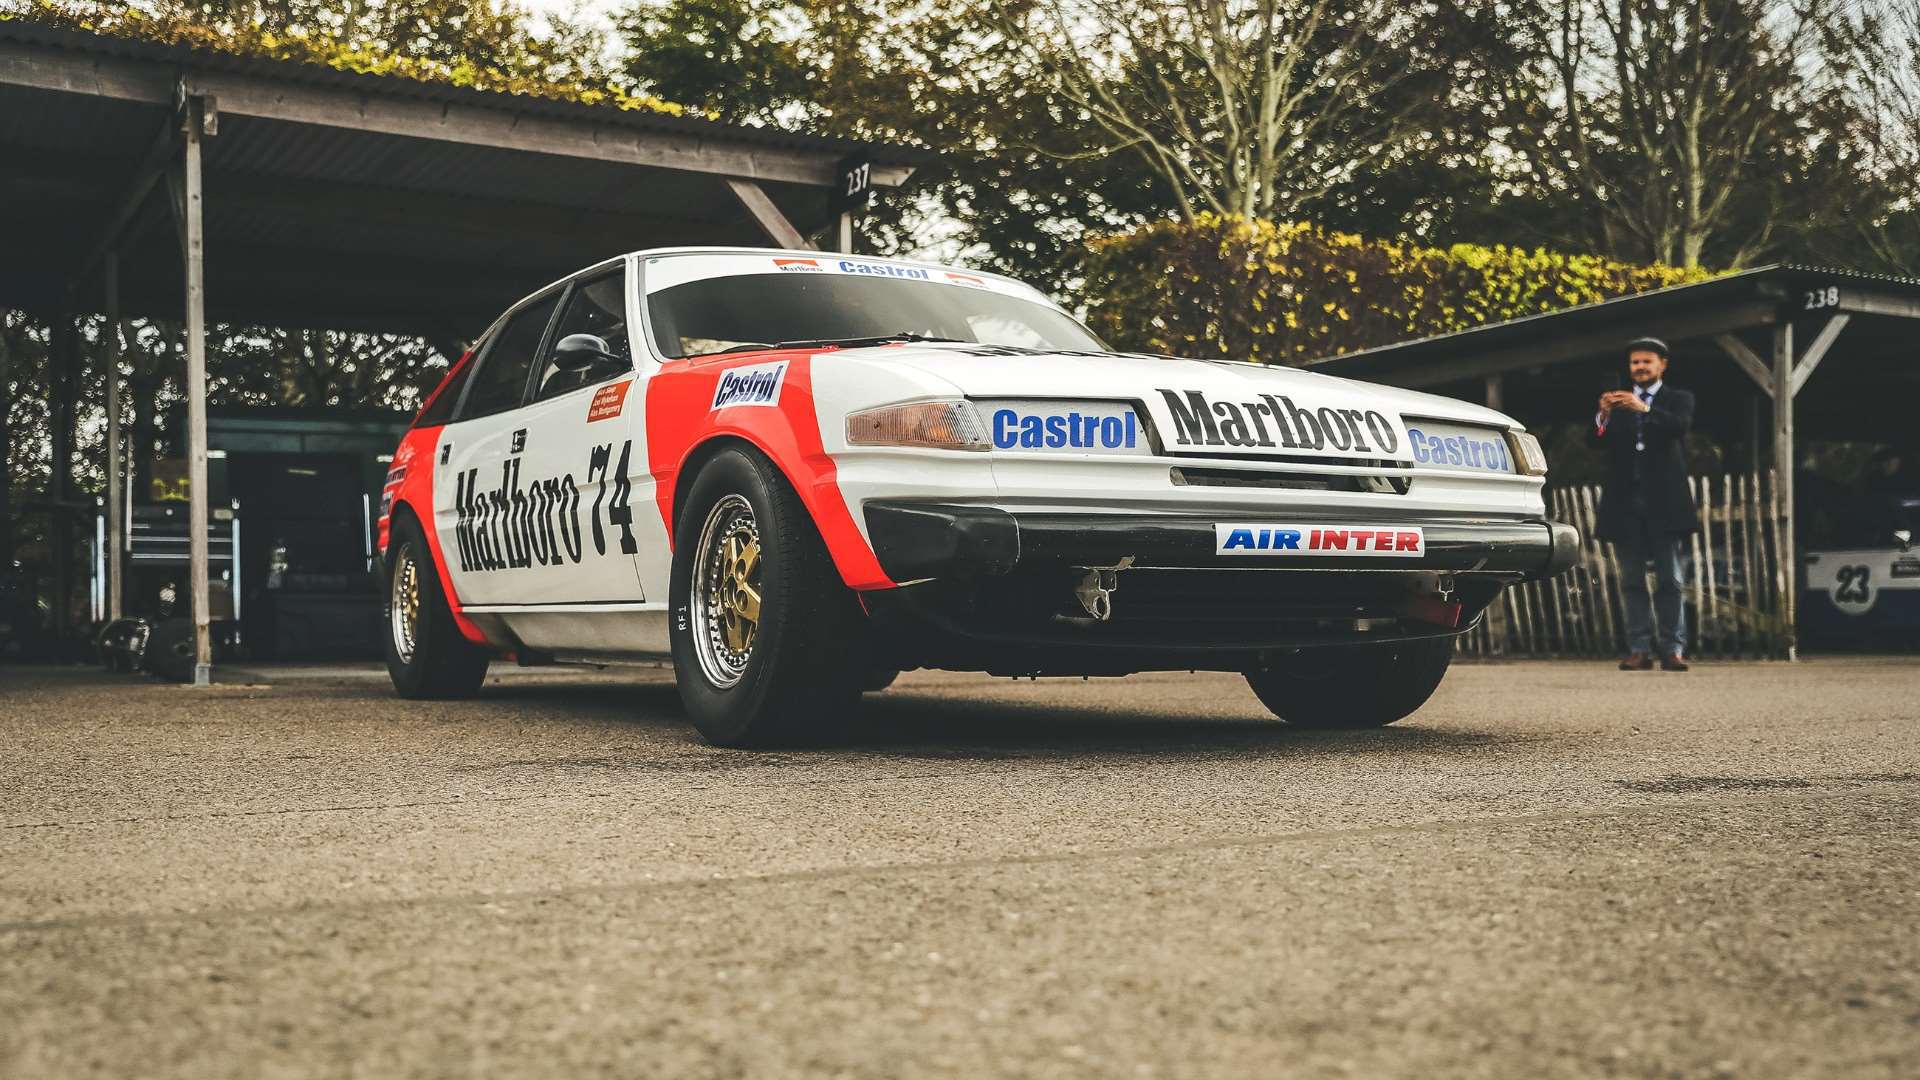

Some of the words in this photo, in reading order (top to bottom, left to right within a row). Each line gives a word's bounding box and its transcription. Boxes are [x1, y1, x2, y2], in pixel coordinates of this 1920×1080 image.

[847, 162, 870, 196] 237
[839, 261, 930, 280] Castrol
[1805, 286, 1839, 310] 238
[715, 365, 784, 407] Castrol
[993, 409, 1136, 449] Castrol
[1154, 388, 1398, 454] Marlboro
[1408, 428, 1508, 472] Castrol
[456, 457, 582, 572] Marlboro
[588, 440, 638, 556] 74
[1222, 528, 1302, 550] AIR
[1308, 530, 1419, 552] INTER
[1836, 565, 1870, 604] 23
[678, 605, 687, 631] RF1
